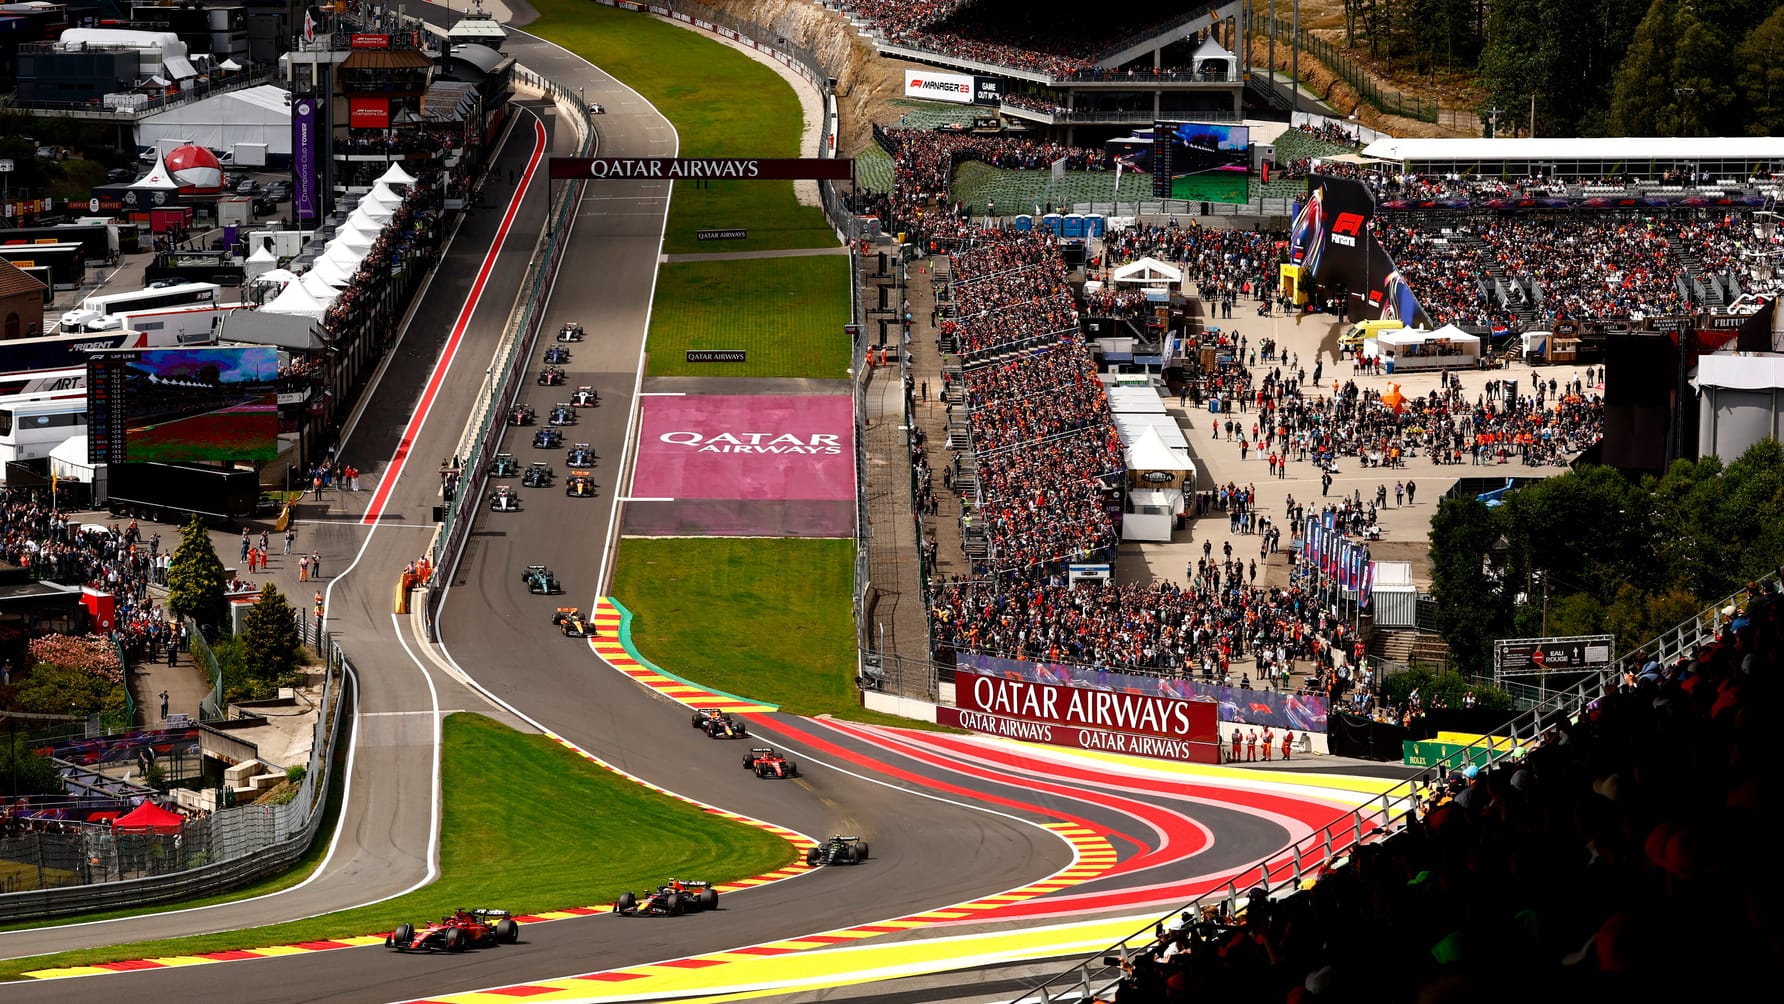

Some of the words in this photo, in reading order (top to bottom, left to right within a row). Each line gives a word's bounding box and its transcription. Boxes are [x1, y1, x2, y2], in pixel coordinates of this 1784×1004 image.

[981, 82, 997, 92] GAME
[977, 91, 988, 99] OUT
[590, 159, 662, 178] QATAR
[668, 160, 759, 177] AIRWAYS
[698, 232, 719, 240] QATAR
[719, 231, 746, 239] AIRWAYS
[48, 376, 82, 392] ART
[659, 431, 841, 446] QATAR
[697, 445, 841, 455] AIRWAYS
[1545, 655, 1569, 663] ROUGE
[973, 676, 1060, 720] QATAR
[1066, 689, 1190, 735] AIRWAYS
[958, 710, 997, 733] QATAR
[998, 717, 1052, 743] AIRWAYS
[1078, 729, 1126, 751] QATAR
[1128, 735, 1190, 760] AIRWAYS
[1409, 756, 1427, 765] ROLEX
